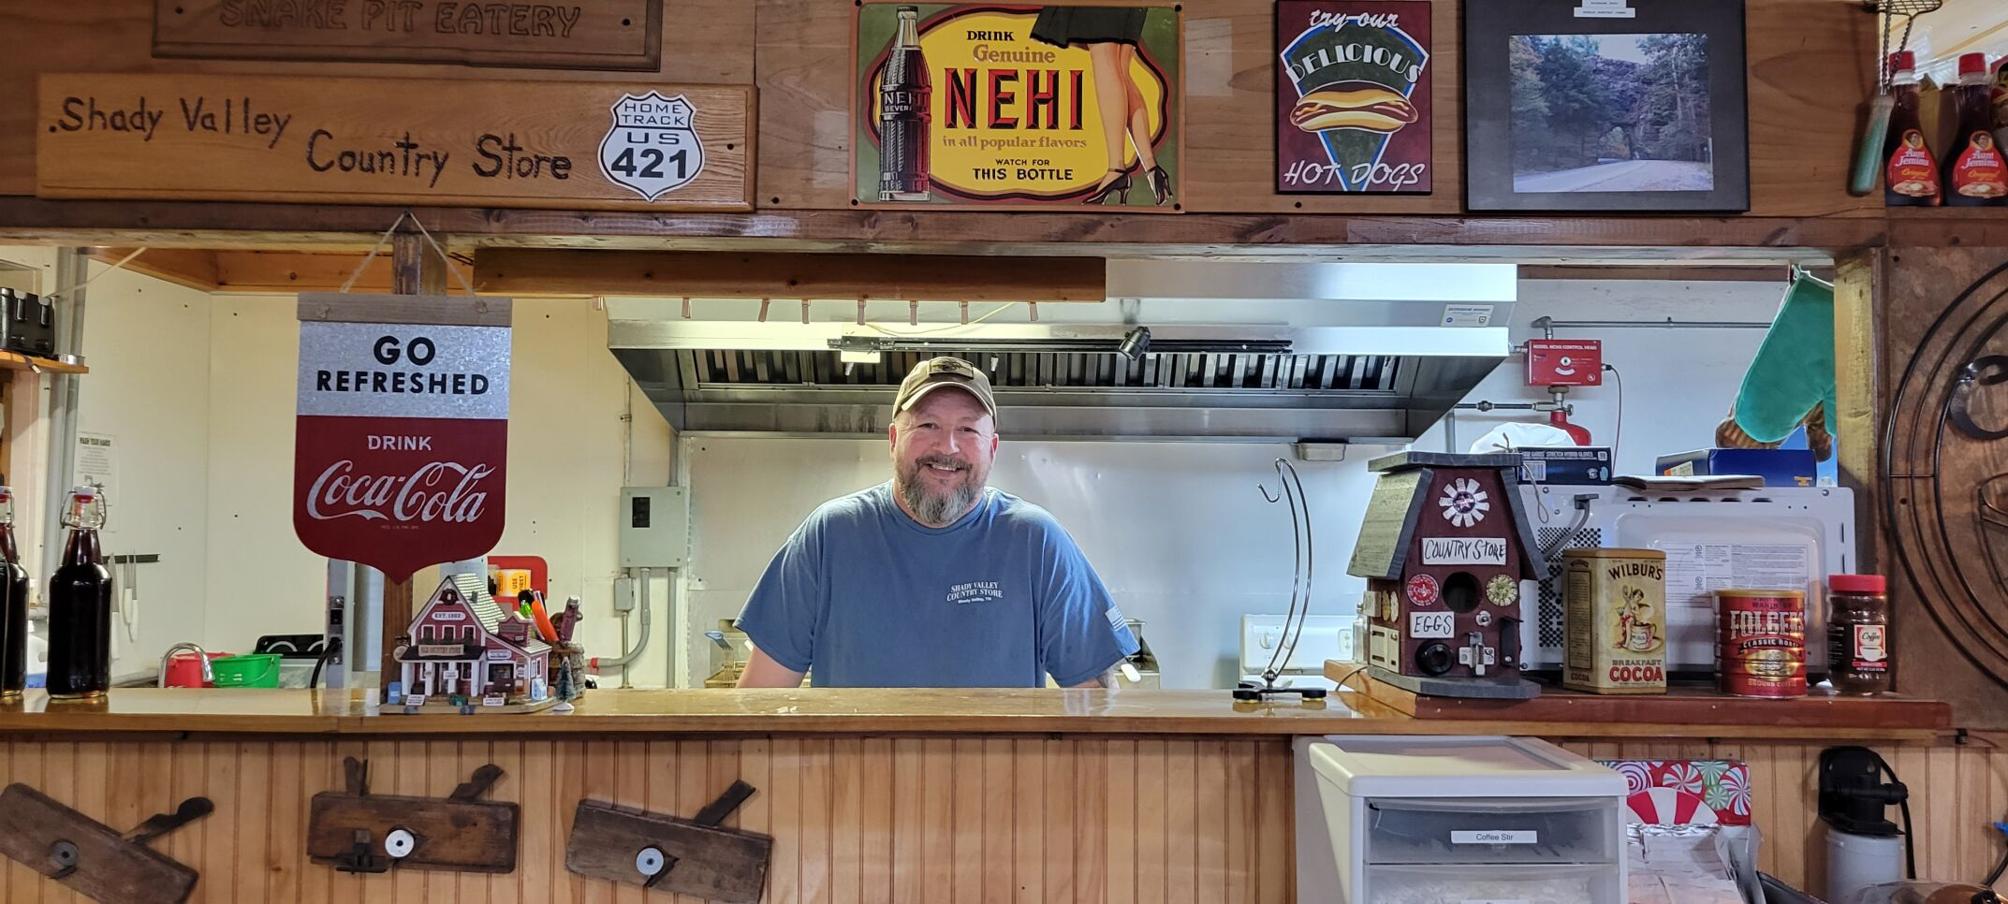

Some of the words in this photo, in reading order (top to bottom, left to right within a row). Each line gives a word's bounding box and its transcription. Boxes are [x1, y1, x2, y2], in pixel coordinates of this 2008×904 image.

[219, 0, 347, 30] SNAKE
[361, 2, 423, 32] PIT
[435, 3, 581, 38] EATERY
[1309, 10, 1348, 32] try
[1357, 12, 1399, 27] our
[966, 30, 1015, 42] DRINK
[972, 45, 1056, 64] Genuine
[1286, 43, 1422, 83] DELICIOUS
[944, 68, 1084, 130] NEHI
[624, 103, 683, 114] HOME
[180, 97, 292, 149] Valley
[621, 114, 686, 126] TRACK
[627, 132, 680, 145] US
[943, 136, 956, 148] in
[959, 136, 977, 148] all
[980, 136, 1036, 151] popular
[1039, 136, 1088, 149] flavors
[306, 128, 450, 188] Country
[472, 132, 572, 180] Store
[610, 147, 688, 179] 421
[995, 158, 1028, 166] WATCH
[1032, 158, 1050, 166] FOR
[972, 168, 1007, 180] THIS
[1016, 168, 1073, 180] BOTTLE
[1284, 160, 1341, 185] HOT
[1351, 162, 1425, 191] DOGS
[373, 335, 436, 366] GO
[316, 370, 490, 395] REFRESHED
[368, 435, 432, 451] DRINK
[306, 459, 496, 523] Coca-Cola
[1424, 540, 1471, 559] COUNTRY
[1608, 563, 1663, 581] WILBUR'S
[947, 589, 978, 601] COUNTRY
[979, 589, 1003, 598] STORE
[951, 583, 972, 592] SHADY
[973, 581, 998, 589] VALLEY
[1414, 615, 1452, 635] EGGS
[1743, 639, 1777, 648] CLASSIC
[1609, 667, 1664, 682] COCOA
[1476, 833, 1500, 841] Coffee
[1501, 833, 1513, 841] Stir
